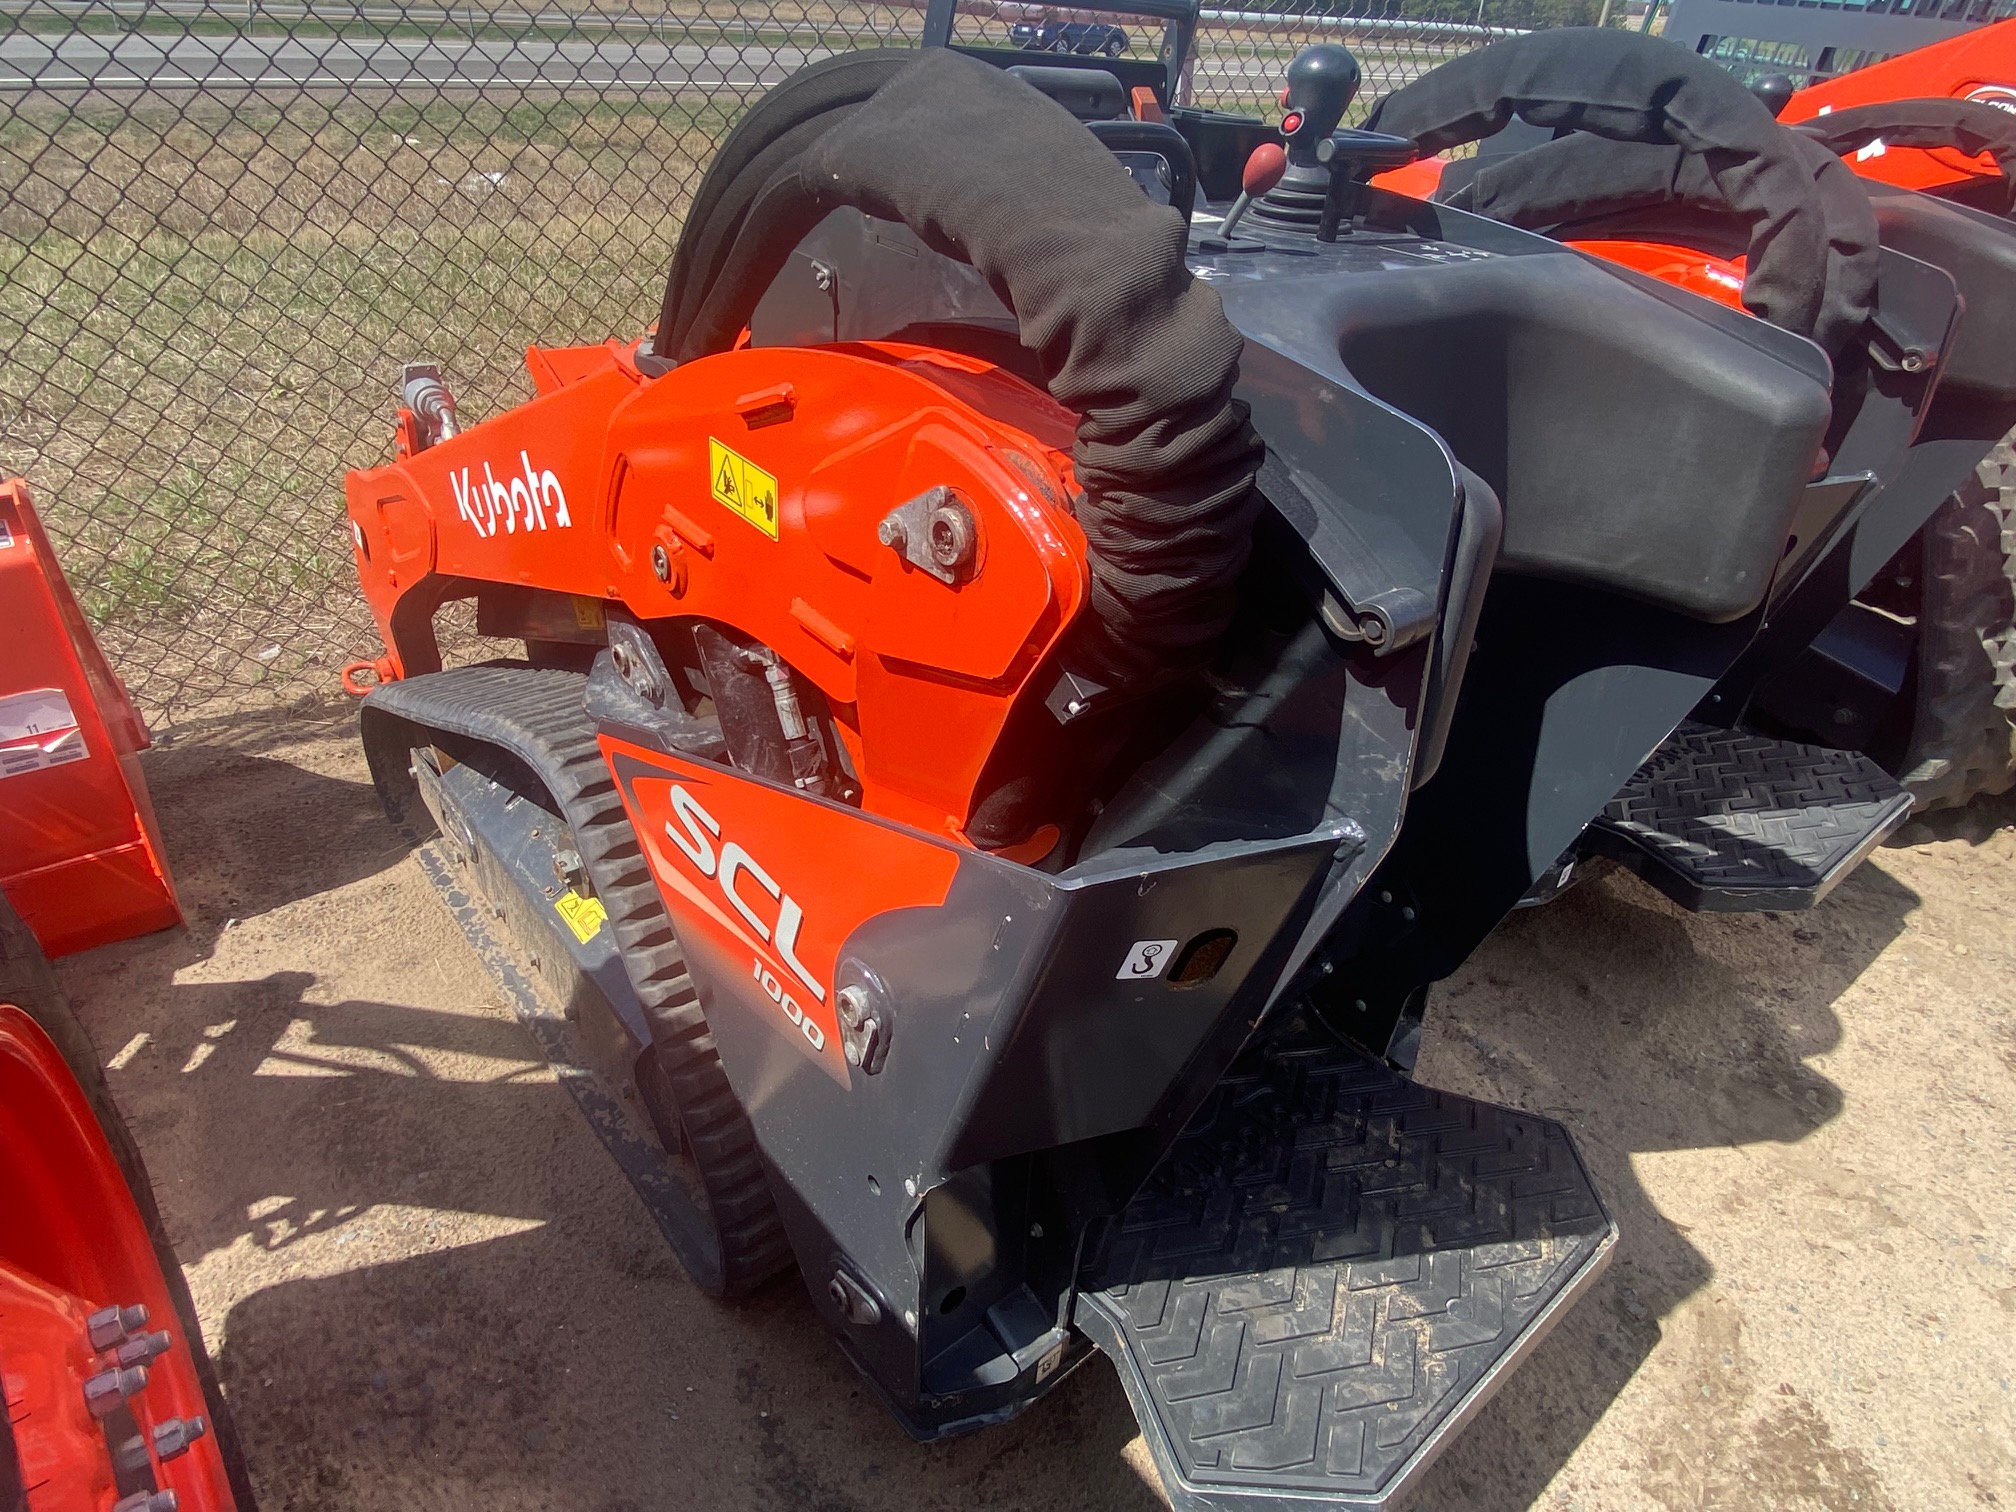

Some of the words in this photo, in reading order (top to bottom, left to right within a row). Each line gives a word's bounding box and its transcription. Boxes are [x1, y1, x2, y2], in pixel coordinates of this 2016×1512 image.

[449, 450, 572, 538] Kubota
[665, 784, 826, 1004] SCL
[753, 956, 826, 1051] 1000
